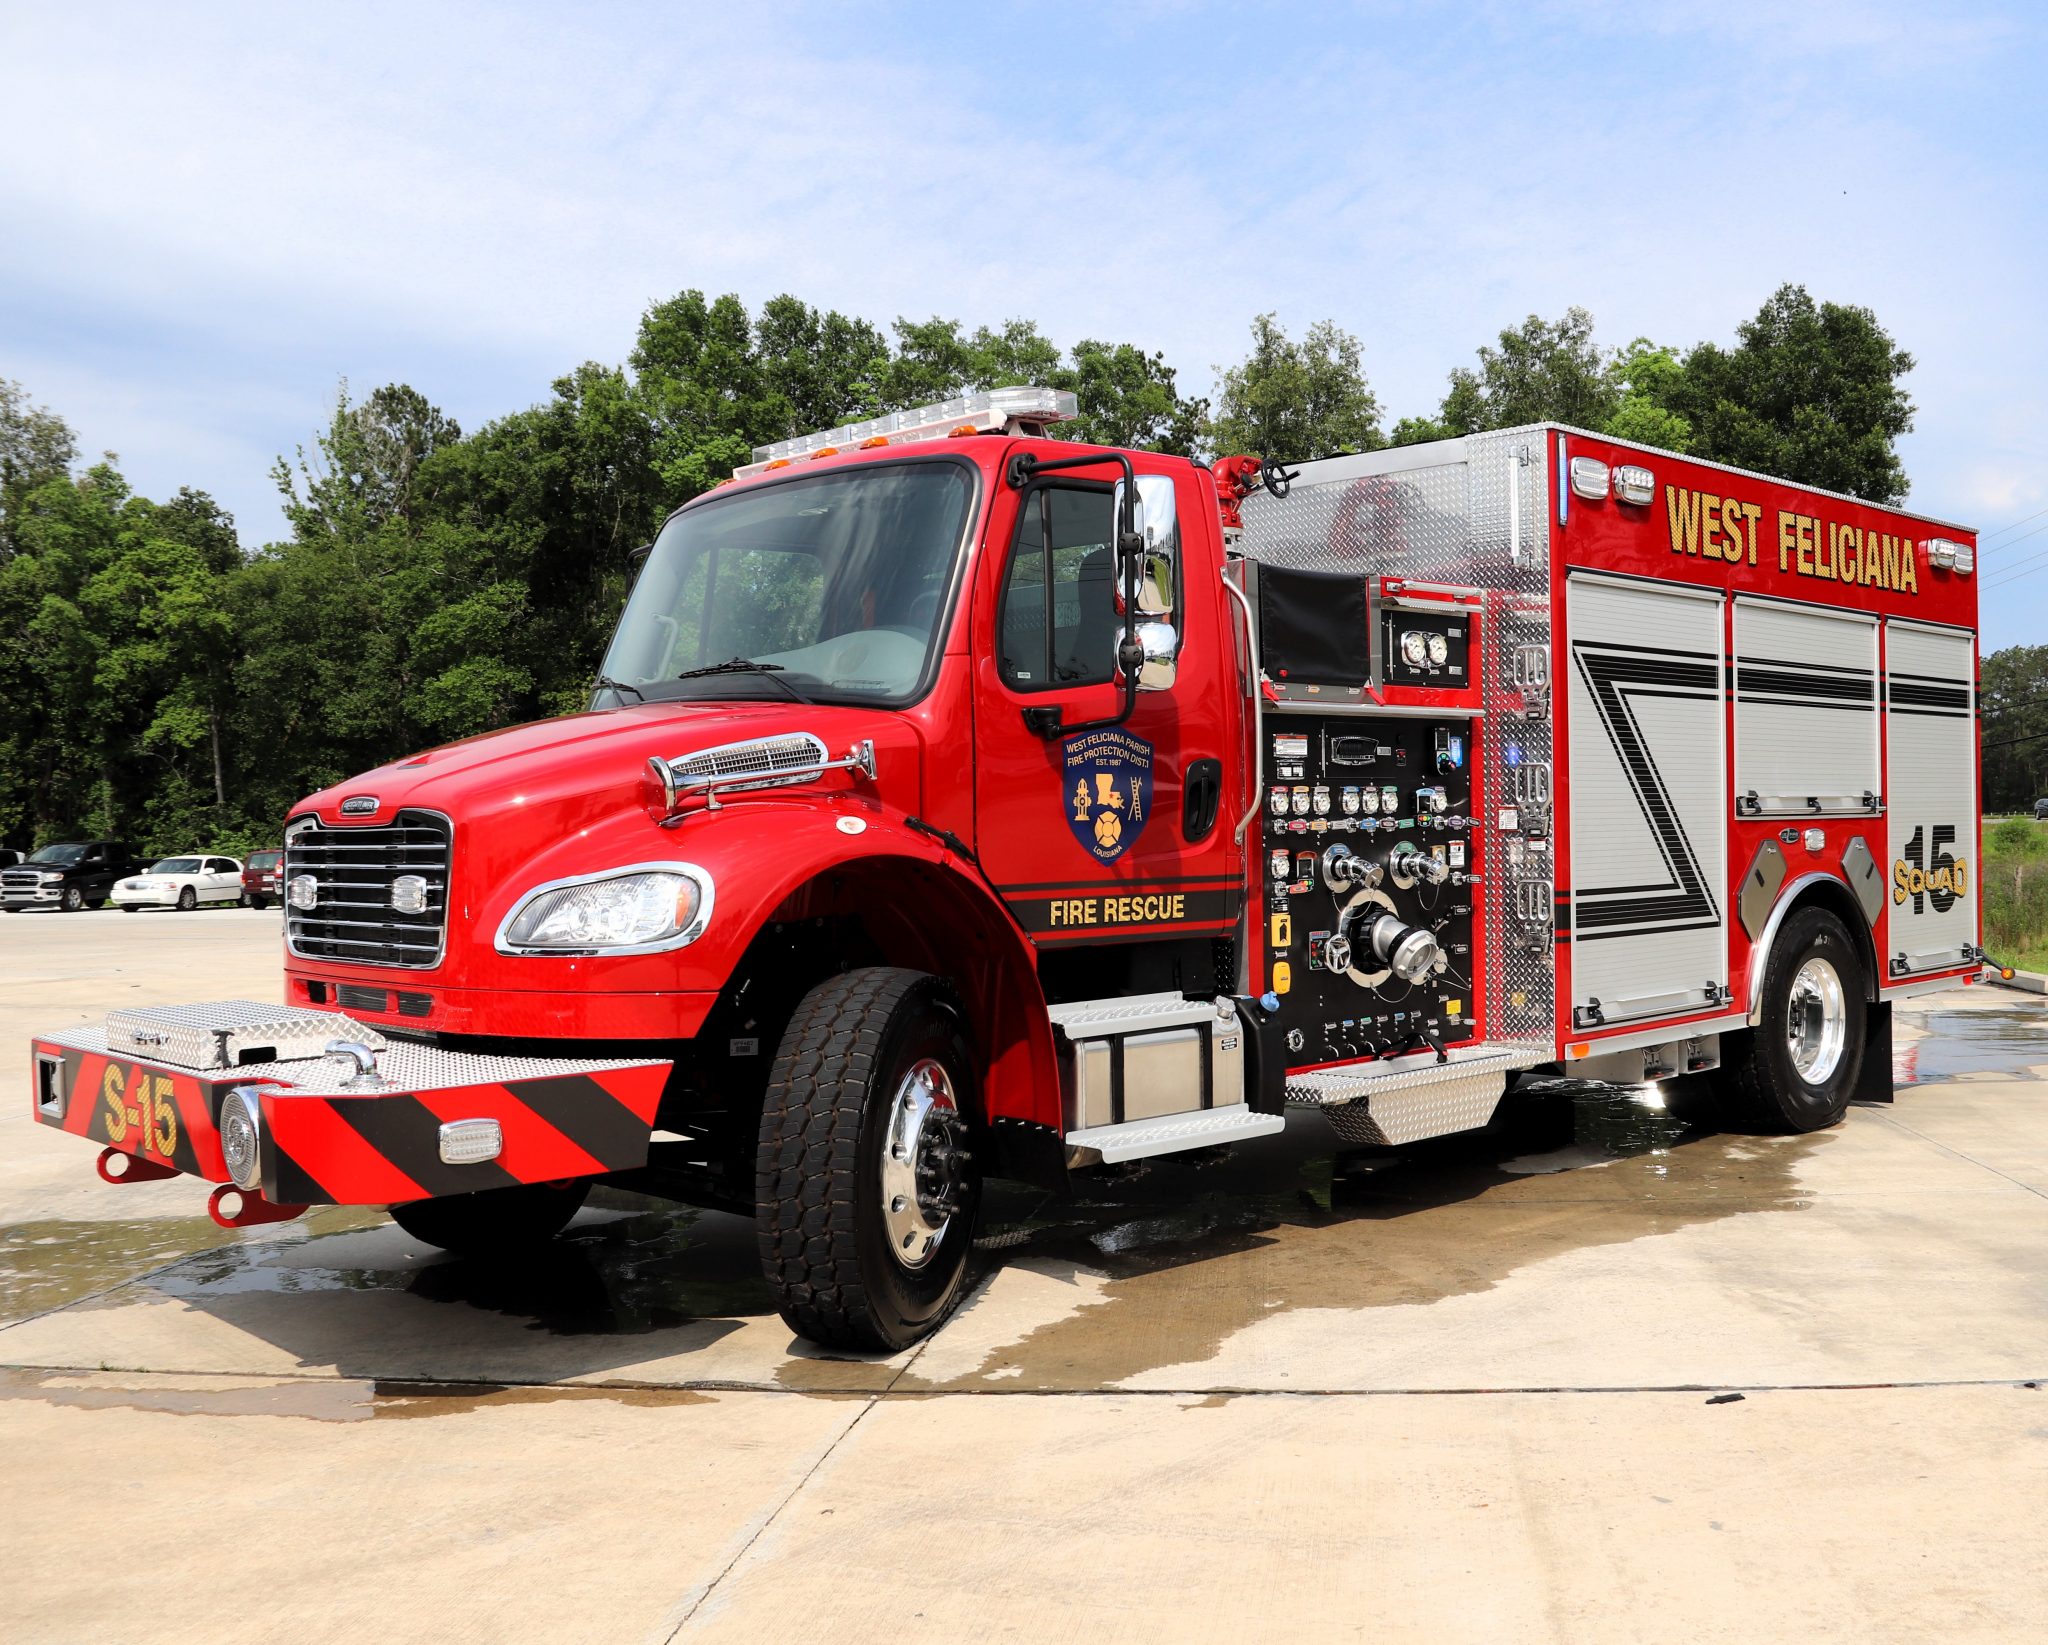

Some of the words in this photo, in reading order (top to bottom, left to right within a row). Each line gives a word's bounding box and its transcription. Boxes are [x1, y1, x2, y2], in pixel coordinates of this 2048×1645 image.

[1665, 485, 1762, 566] WEST
[1778, 510, 1918, 594] FELICIANA
[1066, 738, 1087, 753] WEST
[1087, 732, 1125, 746] FELICIANA
[1125, 737, 1150, 756] PARISH
[1067, 754, 1085, 767] FIRE
[1084, 745, 1130, 761] PROTECTION
[1095, 758, 1108, 766] EST.
[1093, 845, 1122, 858] LOUISIANA
[1893, 857, 1968, 906] SQUAD
[1904, 825, 1955, 914] 15
[1050, 899, 1097, 926] FIRE
[1104, 894, 1185, 923] RESCUE
[104, 1063, 177, 1157] S-15
